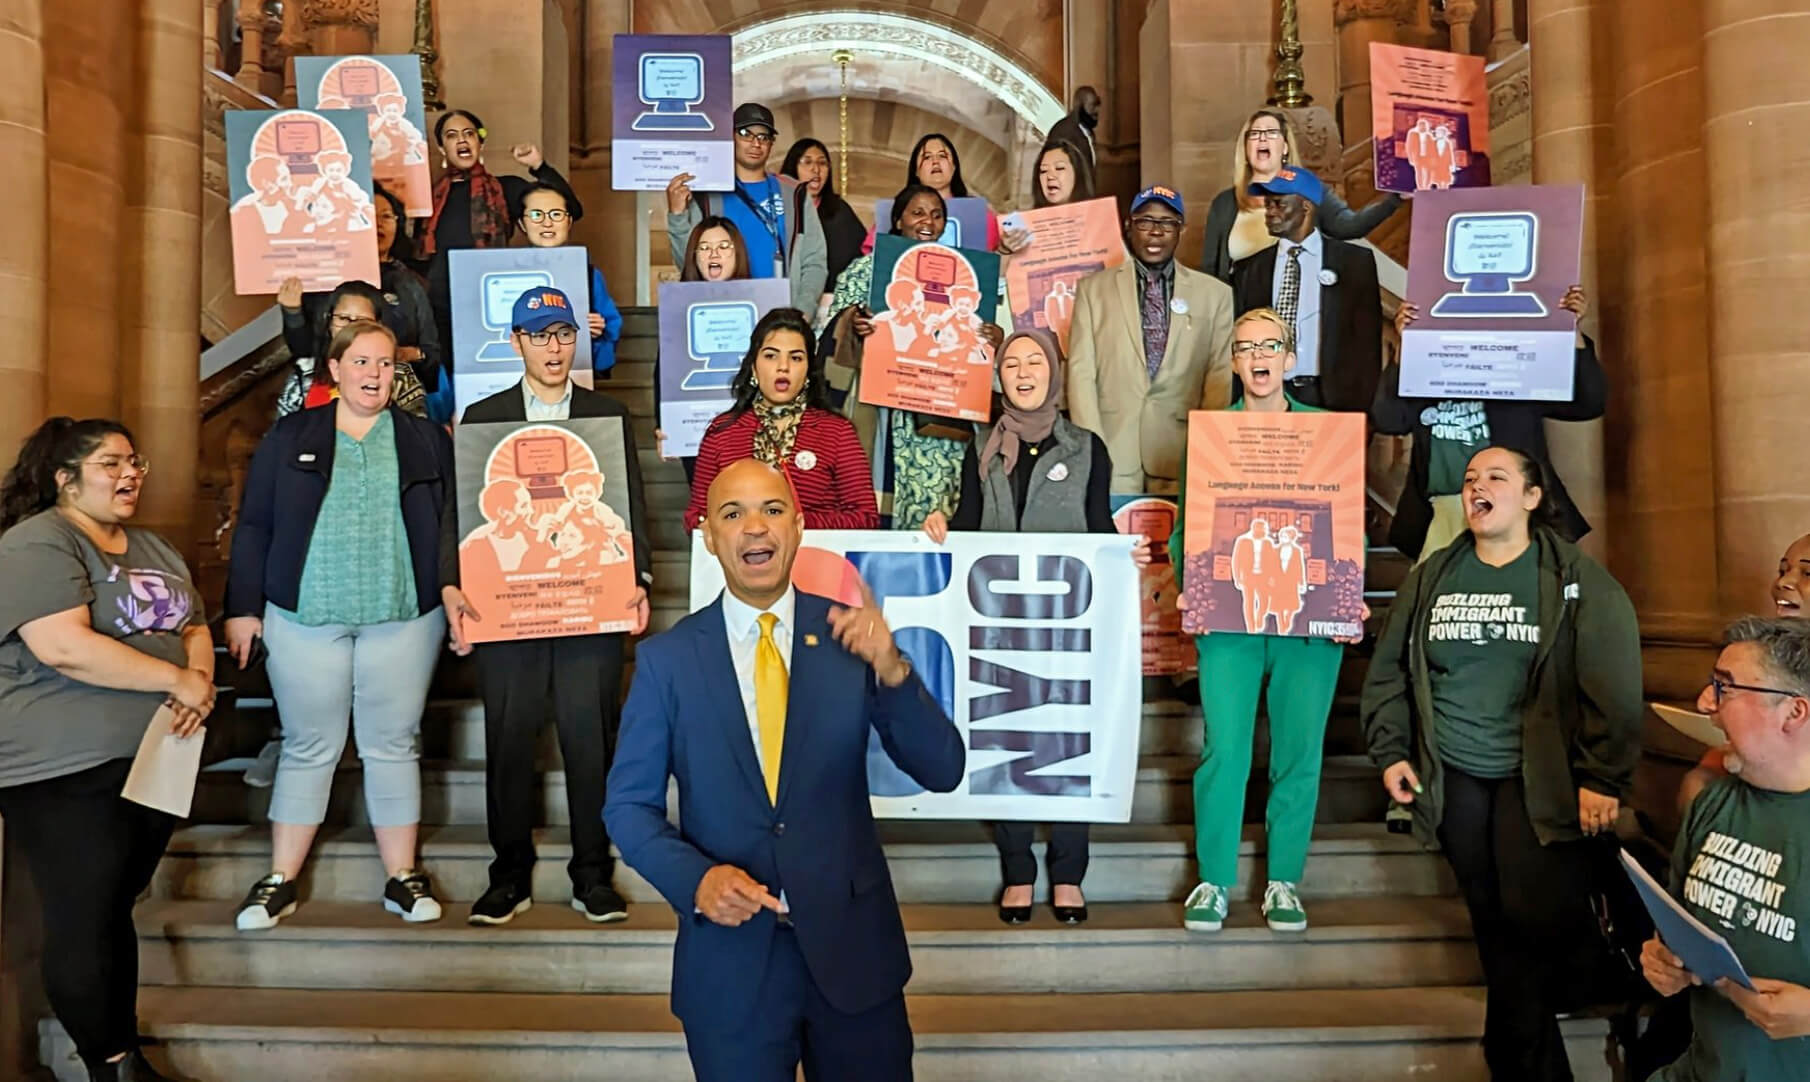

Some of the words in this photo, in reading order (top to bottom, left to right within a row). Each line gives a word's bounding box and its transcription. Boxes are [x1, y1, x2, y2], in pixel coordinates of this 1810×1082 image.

[1469, 344, 1519, 352] WELCOME
[1207, 480, 1249, 491] Language
[1250, 481, 1281, 491] Access
[1282, 481, 1296, 491] for
[1297, 483, 1316, 491] New
[1317, 483, 1341, 493] York!
[537, 580, 585, 589] WELCOME
[1435, 593, 1513, 607] BUILDING
[1430, 606, 1527, 623] IMMIGRANT
[1428, 622, 1482, 641] POWER
[967, 553, 1093, 798] NYIC
[1688, 853, 1786, 909] IMMIGRANT
[1755, 907, 1796, 943] NYIC
